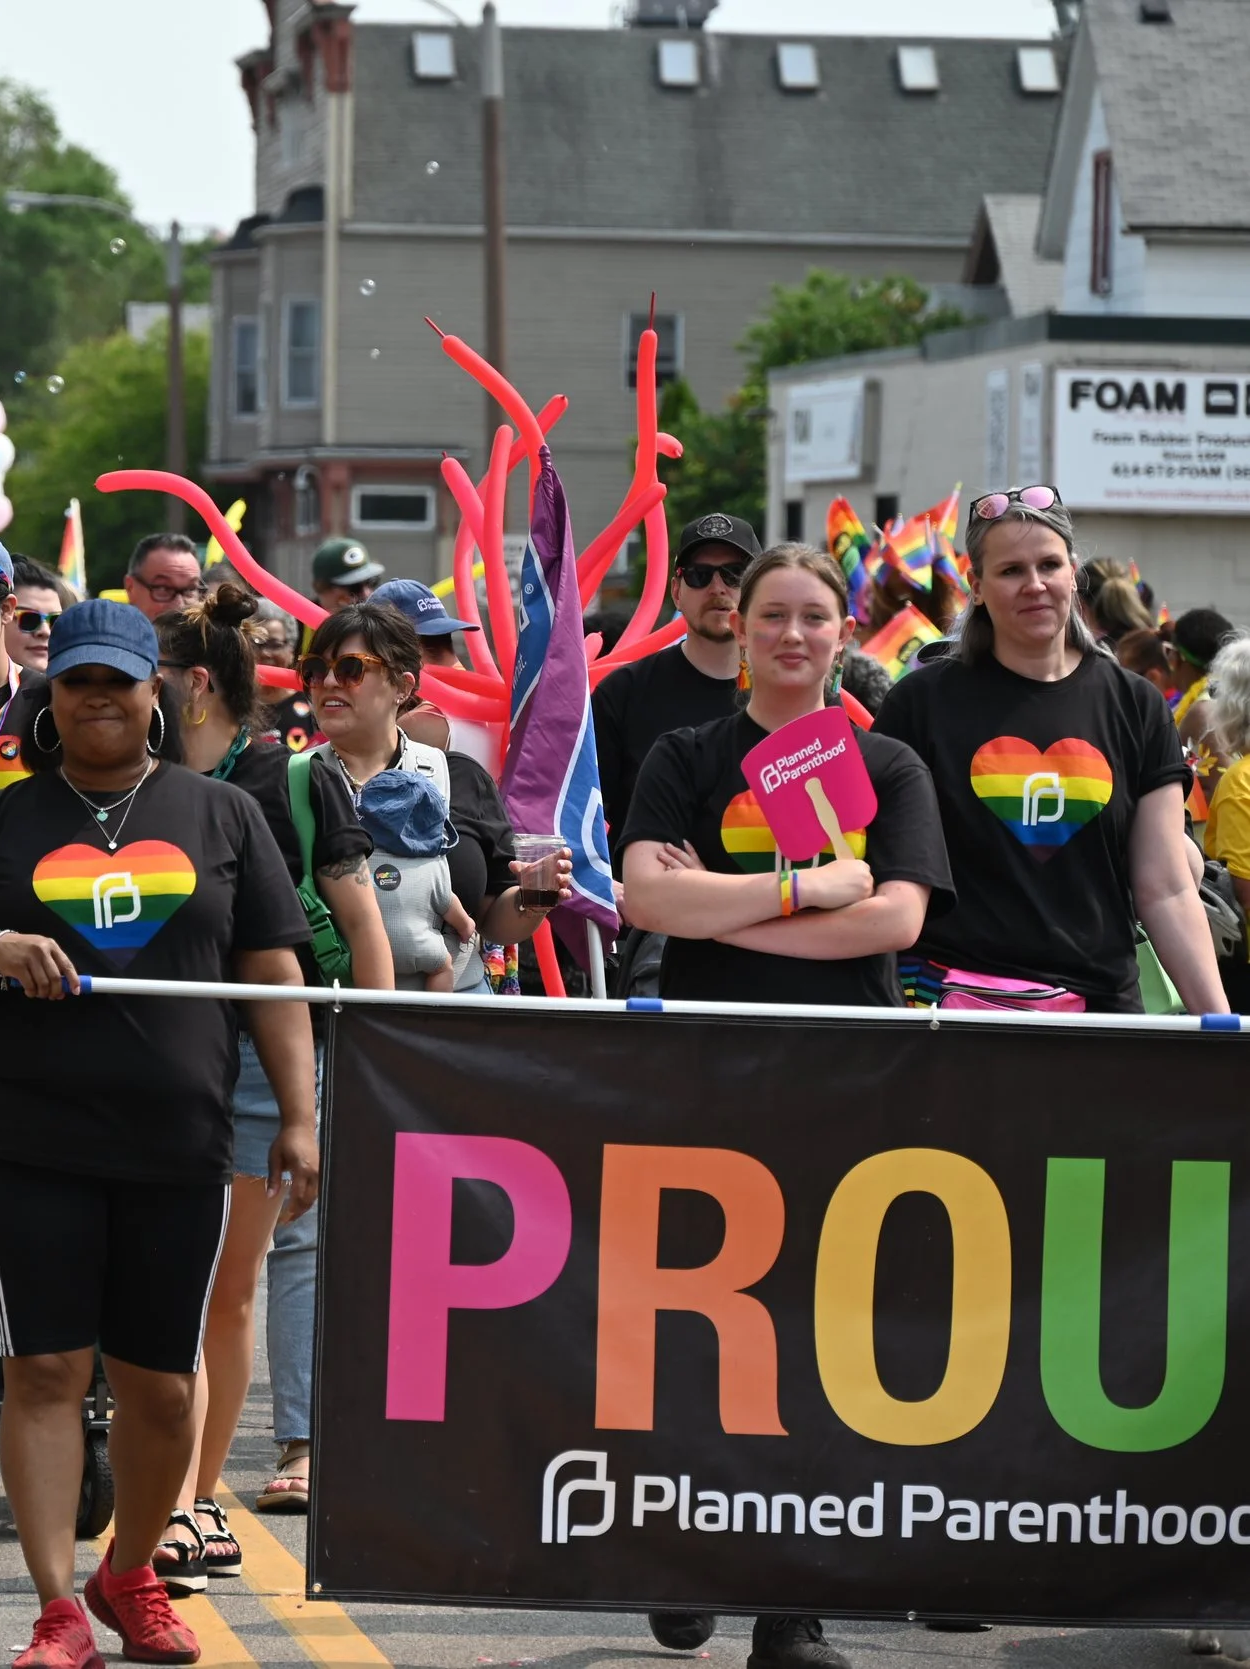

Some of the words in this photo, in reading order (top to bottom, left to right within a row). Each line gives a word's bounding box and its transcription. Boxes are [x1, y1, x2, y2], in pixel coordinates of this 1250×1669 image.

[1069, 379, 1187, 413] FOAM
[775, 738, 823, 771] Planned
[632, 1475, 884, 1538] Planned
